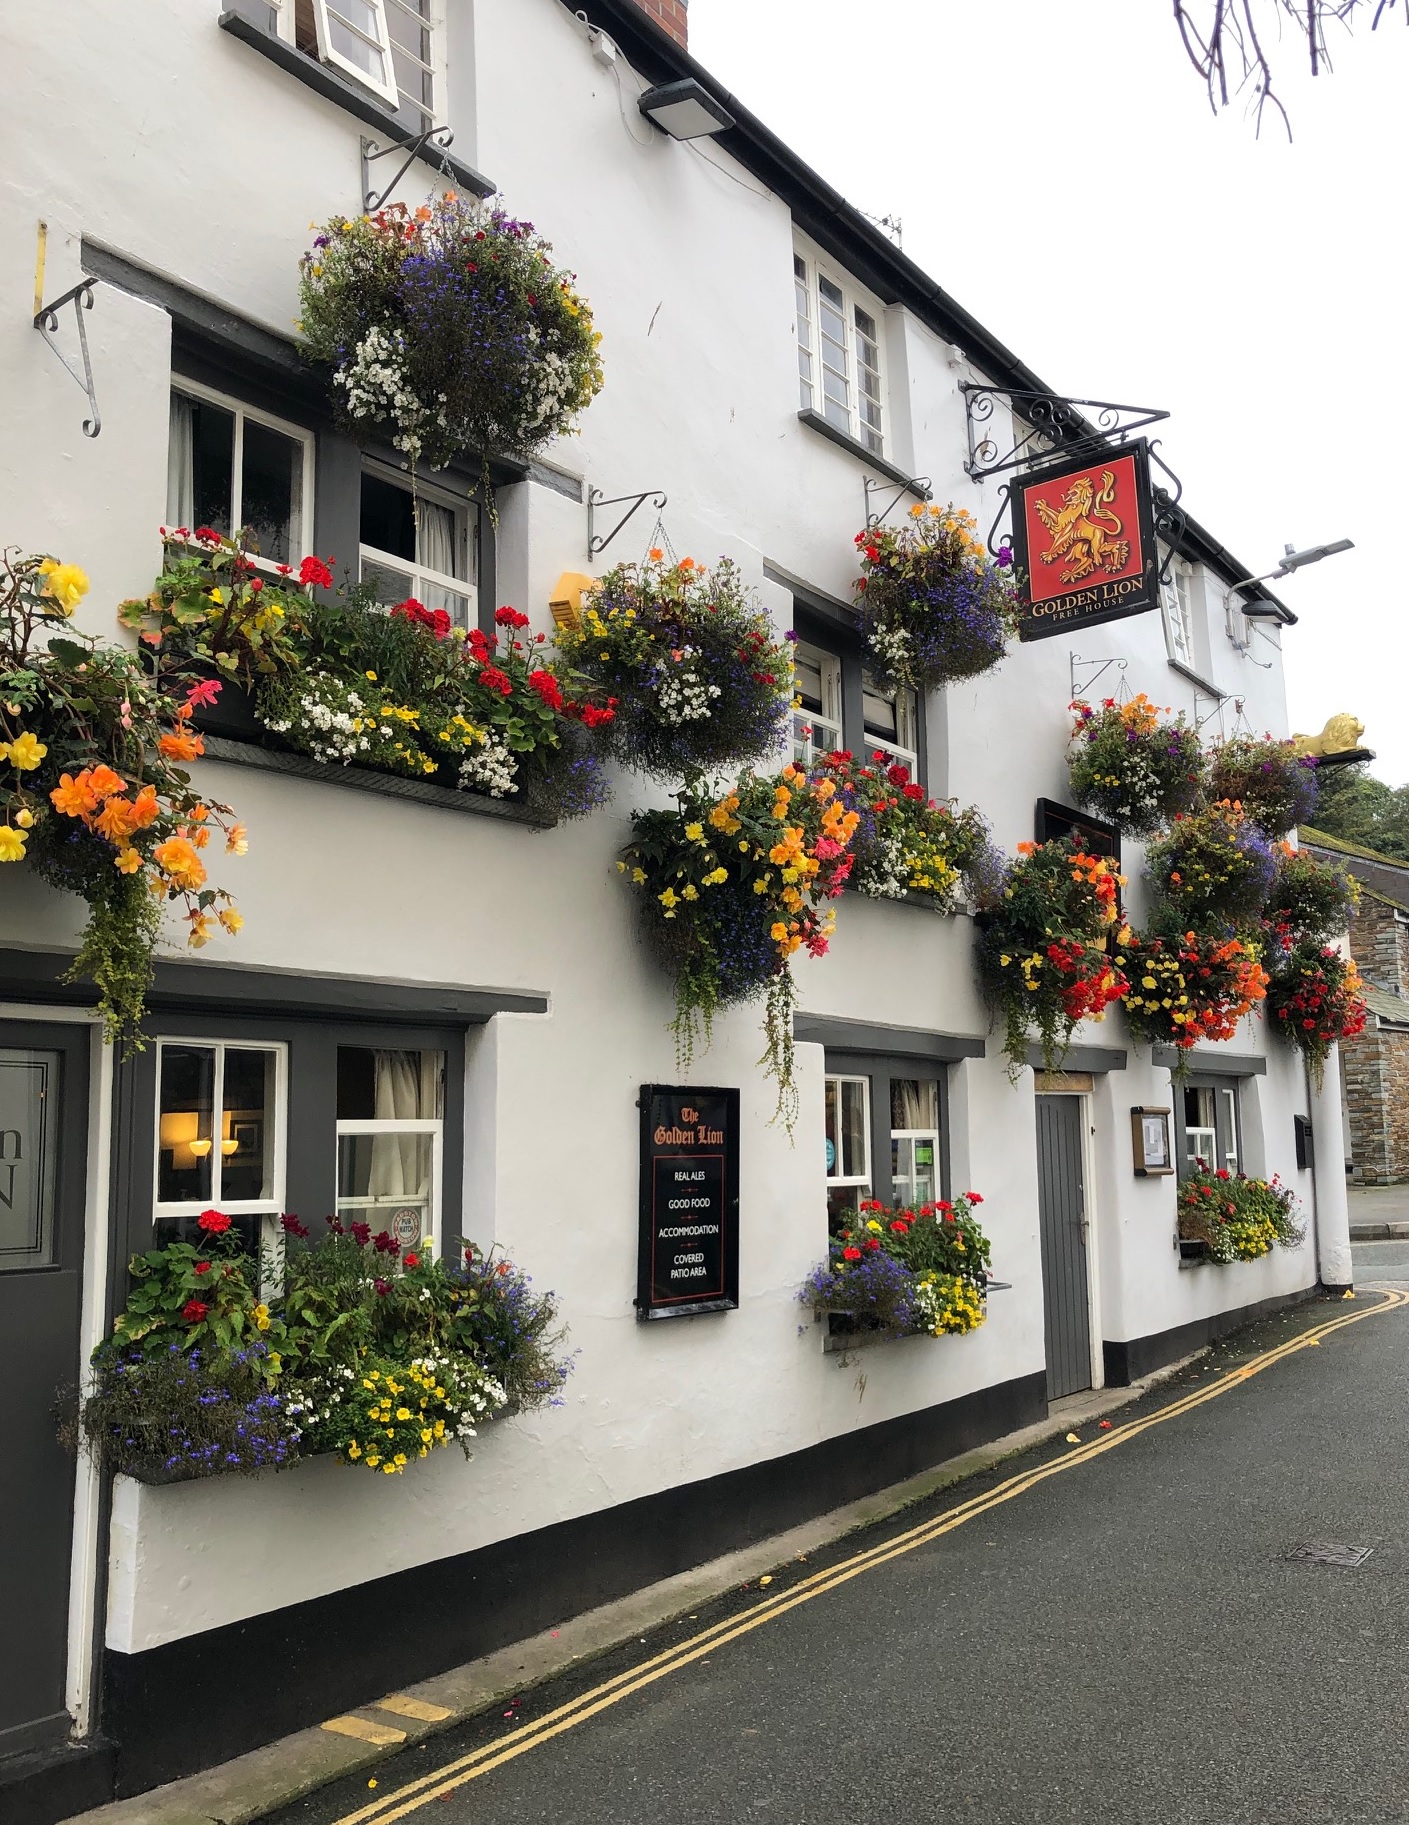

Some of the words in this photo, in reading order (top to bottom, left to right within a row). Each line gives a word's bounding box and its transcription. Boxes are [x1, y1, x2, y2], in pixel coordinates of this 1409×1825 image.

[1032, 589, 1098, 617] GOLDEN
[1102, 577, 1144, 599] LION
[1052, 607, 1080, 621] FREE
[1085, 596, 1125, 613] HOUSE
[681, 1107, 699, 1125] The
[654, 1125, 695, 1145] Golden
[697, 1125, 724, 1145] Lion
[674, 1171, 690, 1181] REAL
[690, 1171, 706, 1181] ALES
[668, 1198, 690, 1209] GOOD
[691, 1197, 711, 1208] FOOD
[658, 1224, 719, 1238] ACCOMMODATION
[673, 1252, 705, 1265] COVERED
[670, 1268, 689, 1279] PATIO
[690, 1266, 707, 1277] AREA
